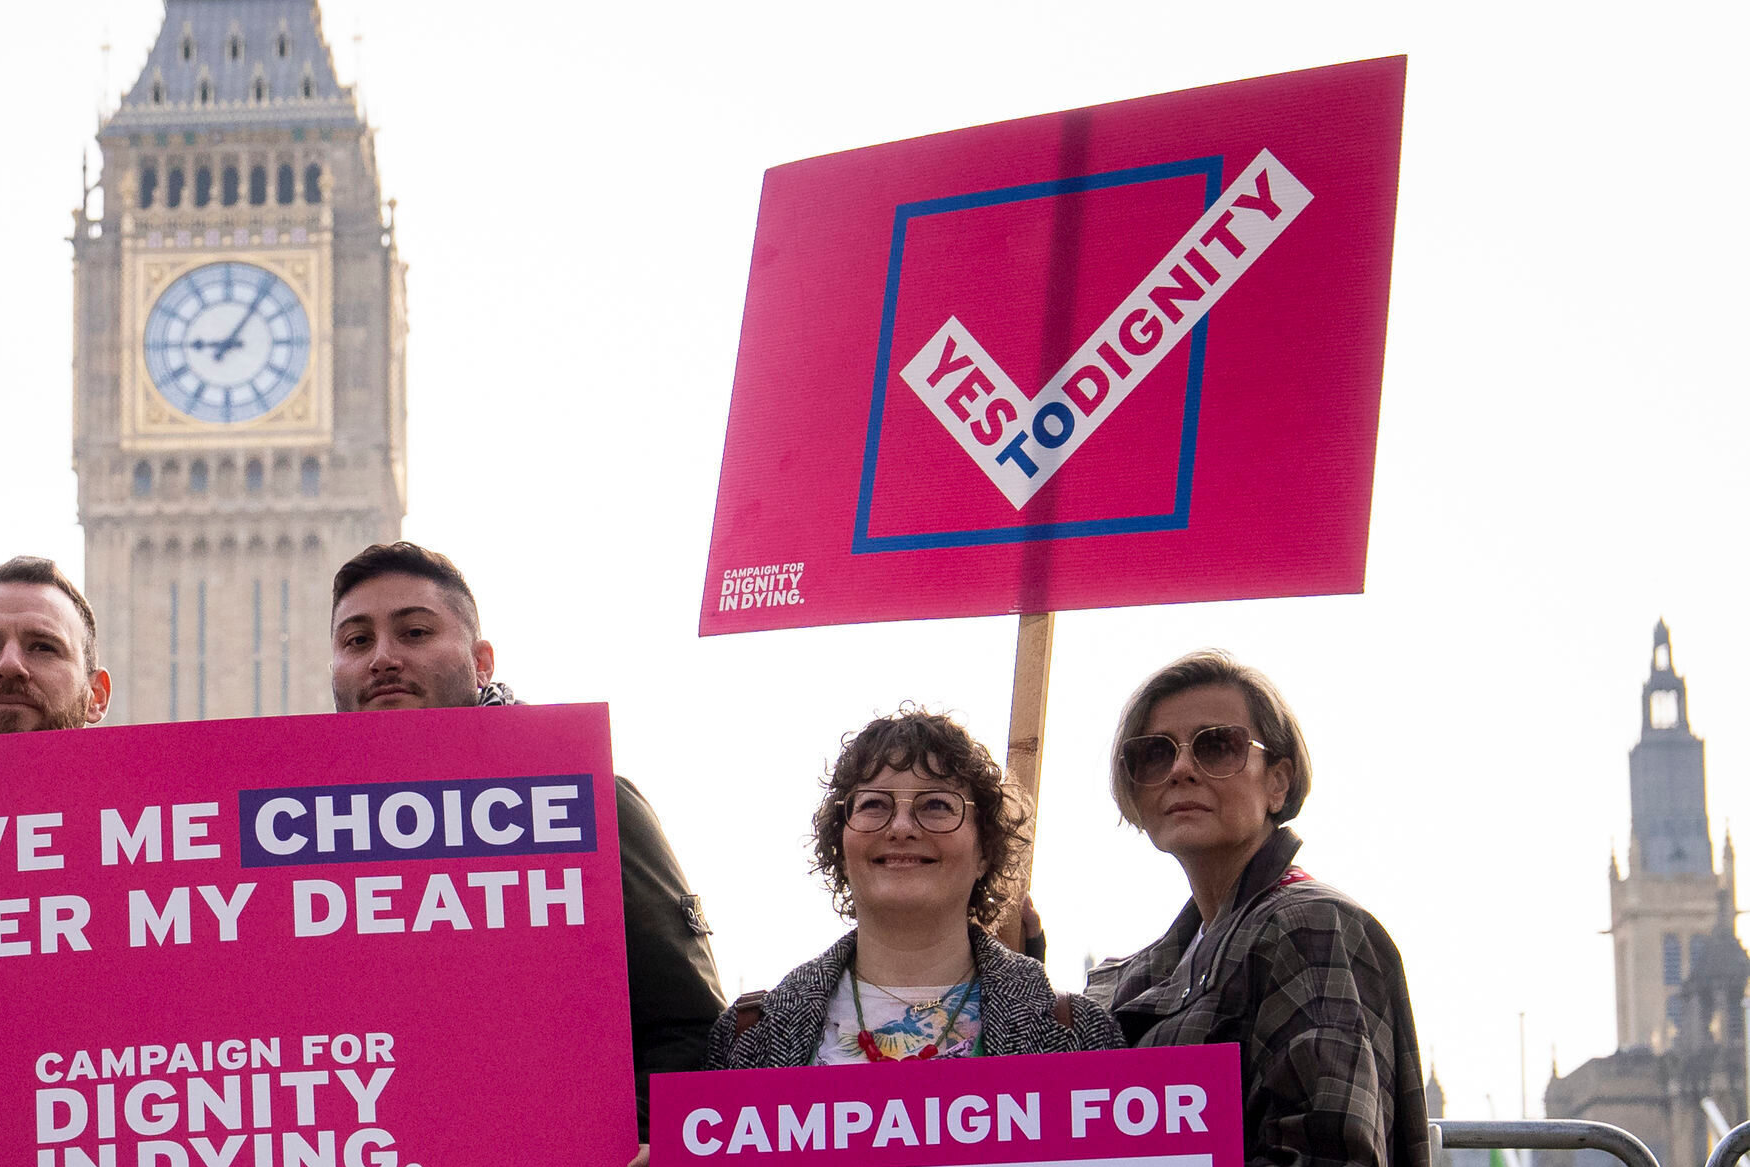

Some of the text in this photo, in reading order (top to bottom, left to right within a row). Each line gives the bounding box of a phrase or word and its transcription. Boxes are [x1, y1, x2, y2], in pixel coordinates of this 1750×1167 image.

[926, 335, 1017, 446] YES
[719, 589, 805, 612] IN DYING.
[721, 572, 803, 596] DIGNITY
[724, 562, 805, 580] CAMPAIGN FOR
[100, 801, 221, 866] ME
[254, 784, 582, 856] CHOICE
[128, 882, 258, 948] MY
[292, 867, 585, 938] DEATH
[35, 1032, 396, 1084] CAMPAIGN FOR
[35, 1067, 396, 1145] DIGNITY
[682, 1084, 1209, 1156] CAMPAIGN FOR
